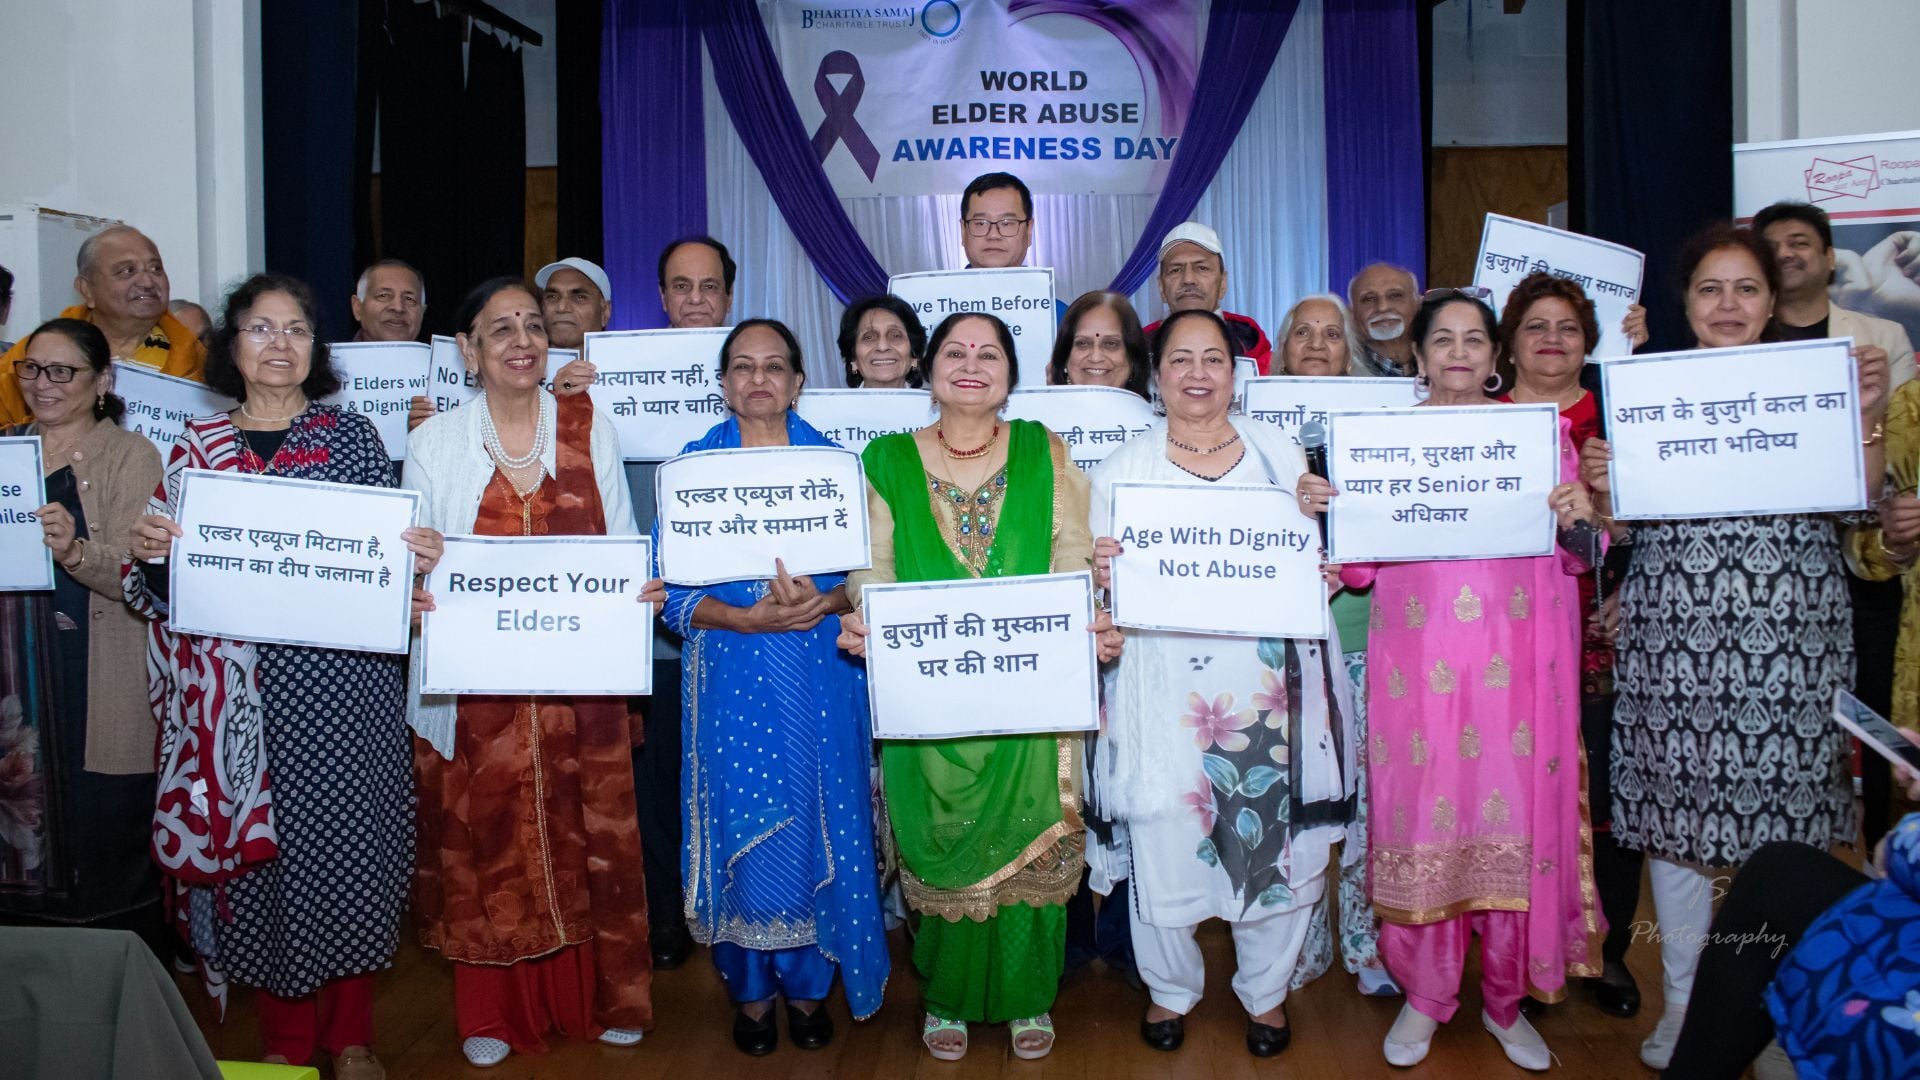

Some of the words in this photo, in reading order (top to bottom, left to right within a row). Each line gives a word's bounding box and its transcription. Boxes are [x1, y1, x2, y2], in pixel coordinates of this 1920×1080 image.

[801, 8, 871, 29] BHARTIYA
[874, 7, 915, 27] SAMAJ
[815, 21, 873, 29] CHARITABLE
[877, 20, 907, 28] TRUST
[980, 70, 1088, 92] WORLD
[932, 102, 1027, 124] ELDER
[1037, 102, 1139, 124] ABUSE
[892, 136, 1102, 162] AWARENESS
[1114, 137, 1178, 161] DAY
[1485, 251, 1530, 274] बुजुर्गों
[1596, 279, 1637, 301] समाज
[937, 297, 986, 313] Them
[991, 295, 1051, 311] Before
[354, 376, 405, 390] Elders
[437, 366, 459, 386] No
[594, 370, 666, 387] अत्याचार
[671, 363, 709, 388] नहीं,
[126, 400, 162, 421] ging
[363, 398, 413, 416] Dignit
[612, 396, 638, 417] को
[642, 400, 680, 416] प्यार
[1615, 405, 1666, 424] आज
[1671, 397, 1694, 421] के
[1700, 391, 1757, 426] बुजुर्ग
[1763, 394, 1808, 415] कल
[1814, 391, 1847, 411] का
[1088, 424, 1127, 445] सच्चे
[1656, 437, 1718, 461] हमारा
[1724, 428, 1799, 453] भविष्य
[1349, 447, 1416, 467] सम्मान,
[1422, 445, 1475, 468] सुरक्षा
[1480, 439, 1517, 461] और
[675, 487, 729, 508] एल्डर
[733, 485, 794, 508] एब्यूज
[799, 478, 845, 502] रोकें,
[1344, 479, 1383, 495] प्यार
[1388, 478, 1413, 497] हर
[1417, 475, 1491, 494] Senior
[1495, 476, 1522, 492] का
[670, 520, 713, 538] प्यार
[718, 513, 758, 535] और
[763, 515, 829, 535] सम्मान
[833, 508, 848, 529] दें
[1391, 502, 1469, 523] अधिकार
[198, 524, 244, 543] एल्डर
[248, 529, 302, 552] एब्यूज
[305, 529, 363, 554] मिटाना
[367, 535, 385, 560] है,
[1120, 525, 1164, 549] Age
[1169, 526, 1222, 546] With
[1229, 528, 1310, 553] Dignity
[187, 552, 245, 572] सम्मान
[249, 558, 274, 575] का
[278, 556, 311, 579] दीप
[314, 565, 375, 585] जलाना
[378, 566, 392, 588] है
[1158, 558, 1200, 578] Not
[1206, 559, 1277, 579] Abuse
[449, 572, 559, 598] Respect
[566, 572, 630, 594] Your
[496, 609, 581, 632] Elders
[881, 614, 949, 650] बुजुर्गों
[953, 612, 986, 638] की
[991, 613, 1071, 643] मुस्कान
[917, 658, 949, 678] घर
[954, 649, 986, 675] की
[993, 653, 1039, 673] शान
